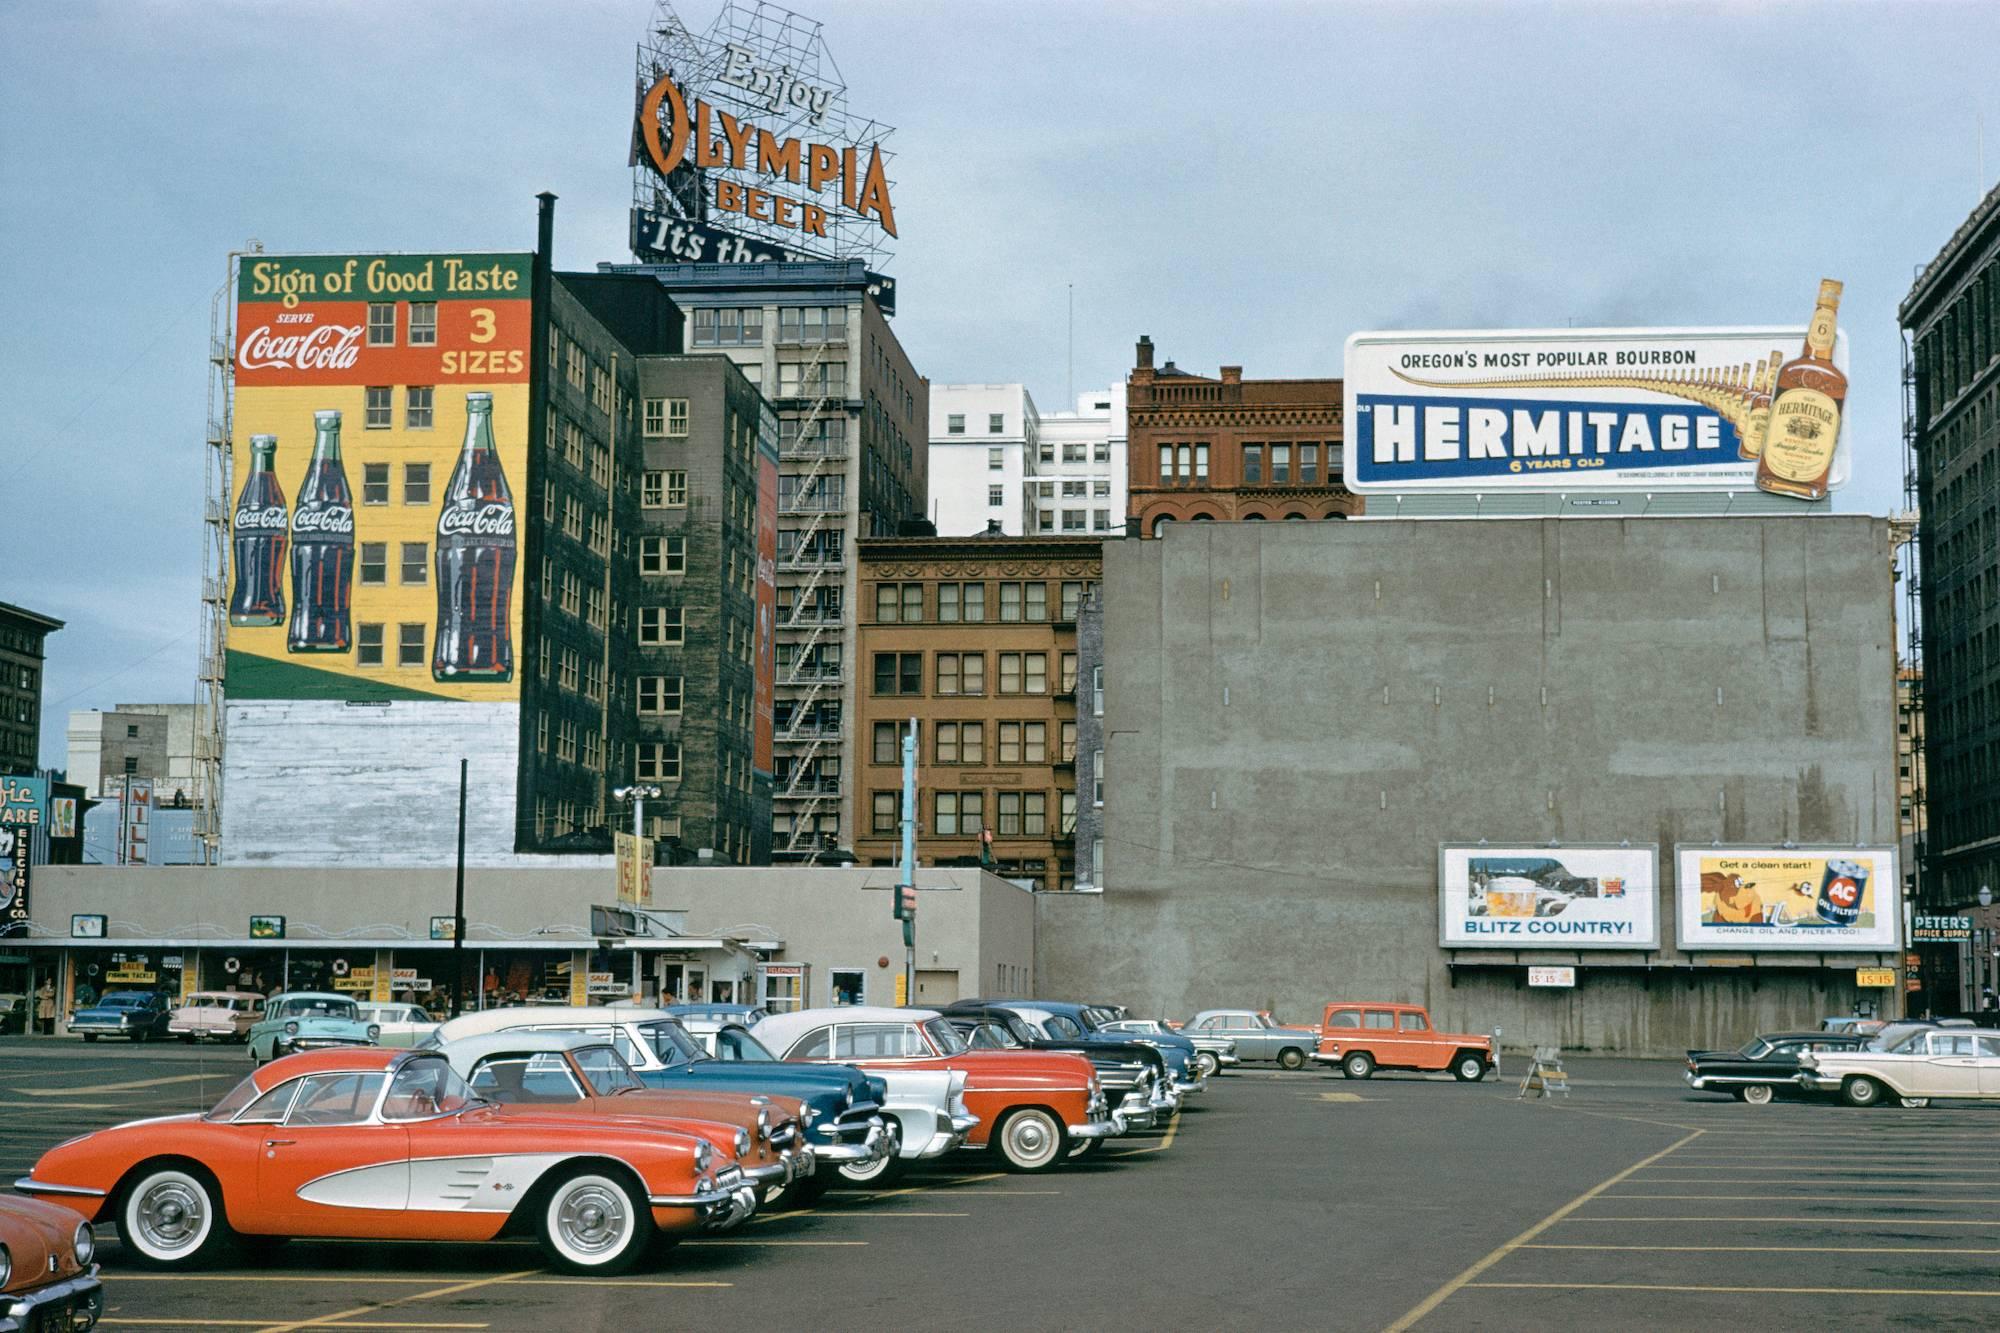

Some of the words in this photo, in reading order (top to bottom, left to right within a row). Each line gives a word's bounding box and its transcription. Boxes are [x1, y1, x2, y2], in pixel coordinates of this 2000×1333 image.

[717, 43, 833, 126] Enjoy
[640, 73, 898, 240] OLYMPIA
[716, 178, 828, 238] BEER
[253, 261, 317, 309] Sign
[323, 259, 358, 293] of
[366, 259, 434, 293] Good
[443, 259, 519, 292] Taste
[276, 313, 315, 324] SERVE
[469, 307, 497, 344] 3
[239, 324, 366, 370] Coca-Cola
[441, 350, 524, 375] SIZES
[1400, 350, 1478, 369] OREGON'S
[1484, 351, 1531, 368] MOST
[1536, 351, 1609, 368] POPULAR
[1616, 349, 1697, 366] BOURBON
[1356, 404, 1371, 413] OLD
[1778, 402, 1834, 425] HERMITAGE
[1372, 403, 1721, 464] HERMITAGE
[1509, 459, 1522, 473] 6
[1526, 458, 1571, 471] YEARS
[1577, 457, 1605, 468] OLD
[234, 506, 288, 529] Coca-Cola
[291, 505, 353, 533] Coca-Cola
[438, 503, 513, 536] Coca-Cola
[15, 828, 28, 908] ELECTRIC
[1719, 860, 1739, 869] Get
[1751, 860, 1780, 869] clean
[1783, 861, 1812, 870] start!
[1828, 881, 1857, 902] AC
[1818, 897, 1832, 911] OIL
[1831, 904, 1860, 917] FILTER
[1465, 921, 1521, 934] BLITZ
[1527, 921, 1633, 934] COUNTRY!
[1914, 916, 1970, 929] PETER'S
[1914, 929, 1941, 938] OFFICE
[1943, 929, 1971, 938] SUPPLY
